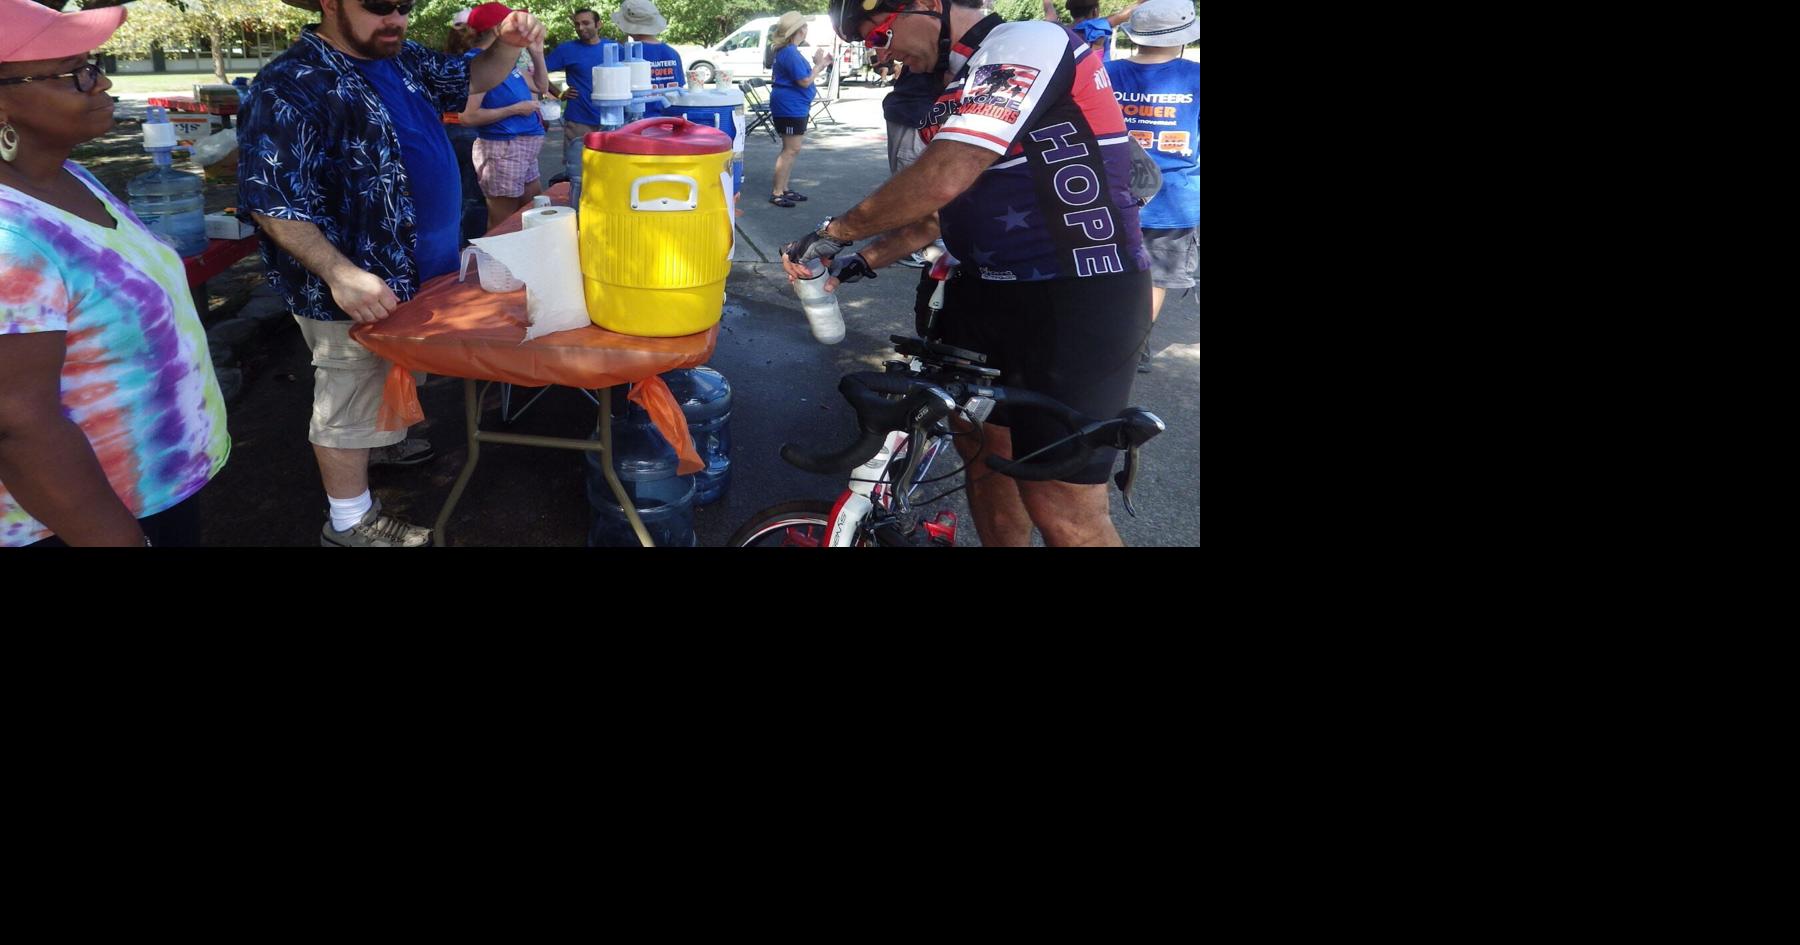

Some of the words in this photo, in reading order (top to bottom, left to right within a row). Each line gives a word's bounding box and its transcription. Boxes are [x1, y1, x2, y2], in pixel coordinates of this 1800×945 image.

[1113, 91, 1193, 104] OLUNTEERS
[956, 102, 1021, 125] WARRIORS
[1138, 118, 1177, 126] movement
[1029, 121, 1124, 277] HOPE
